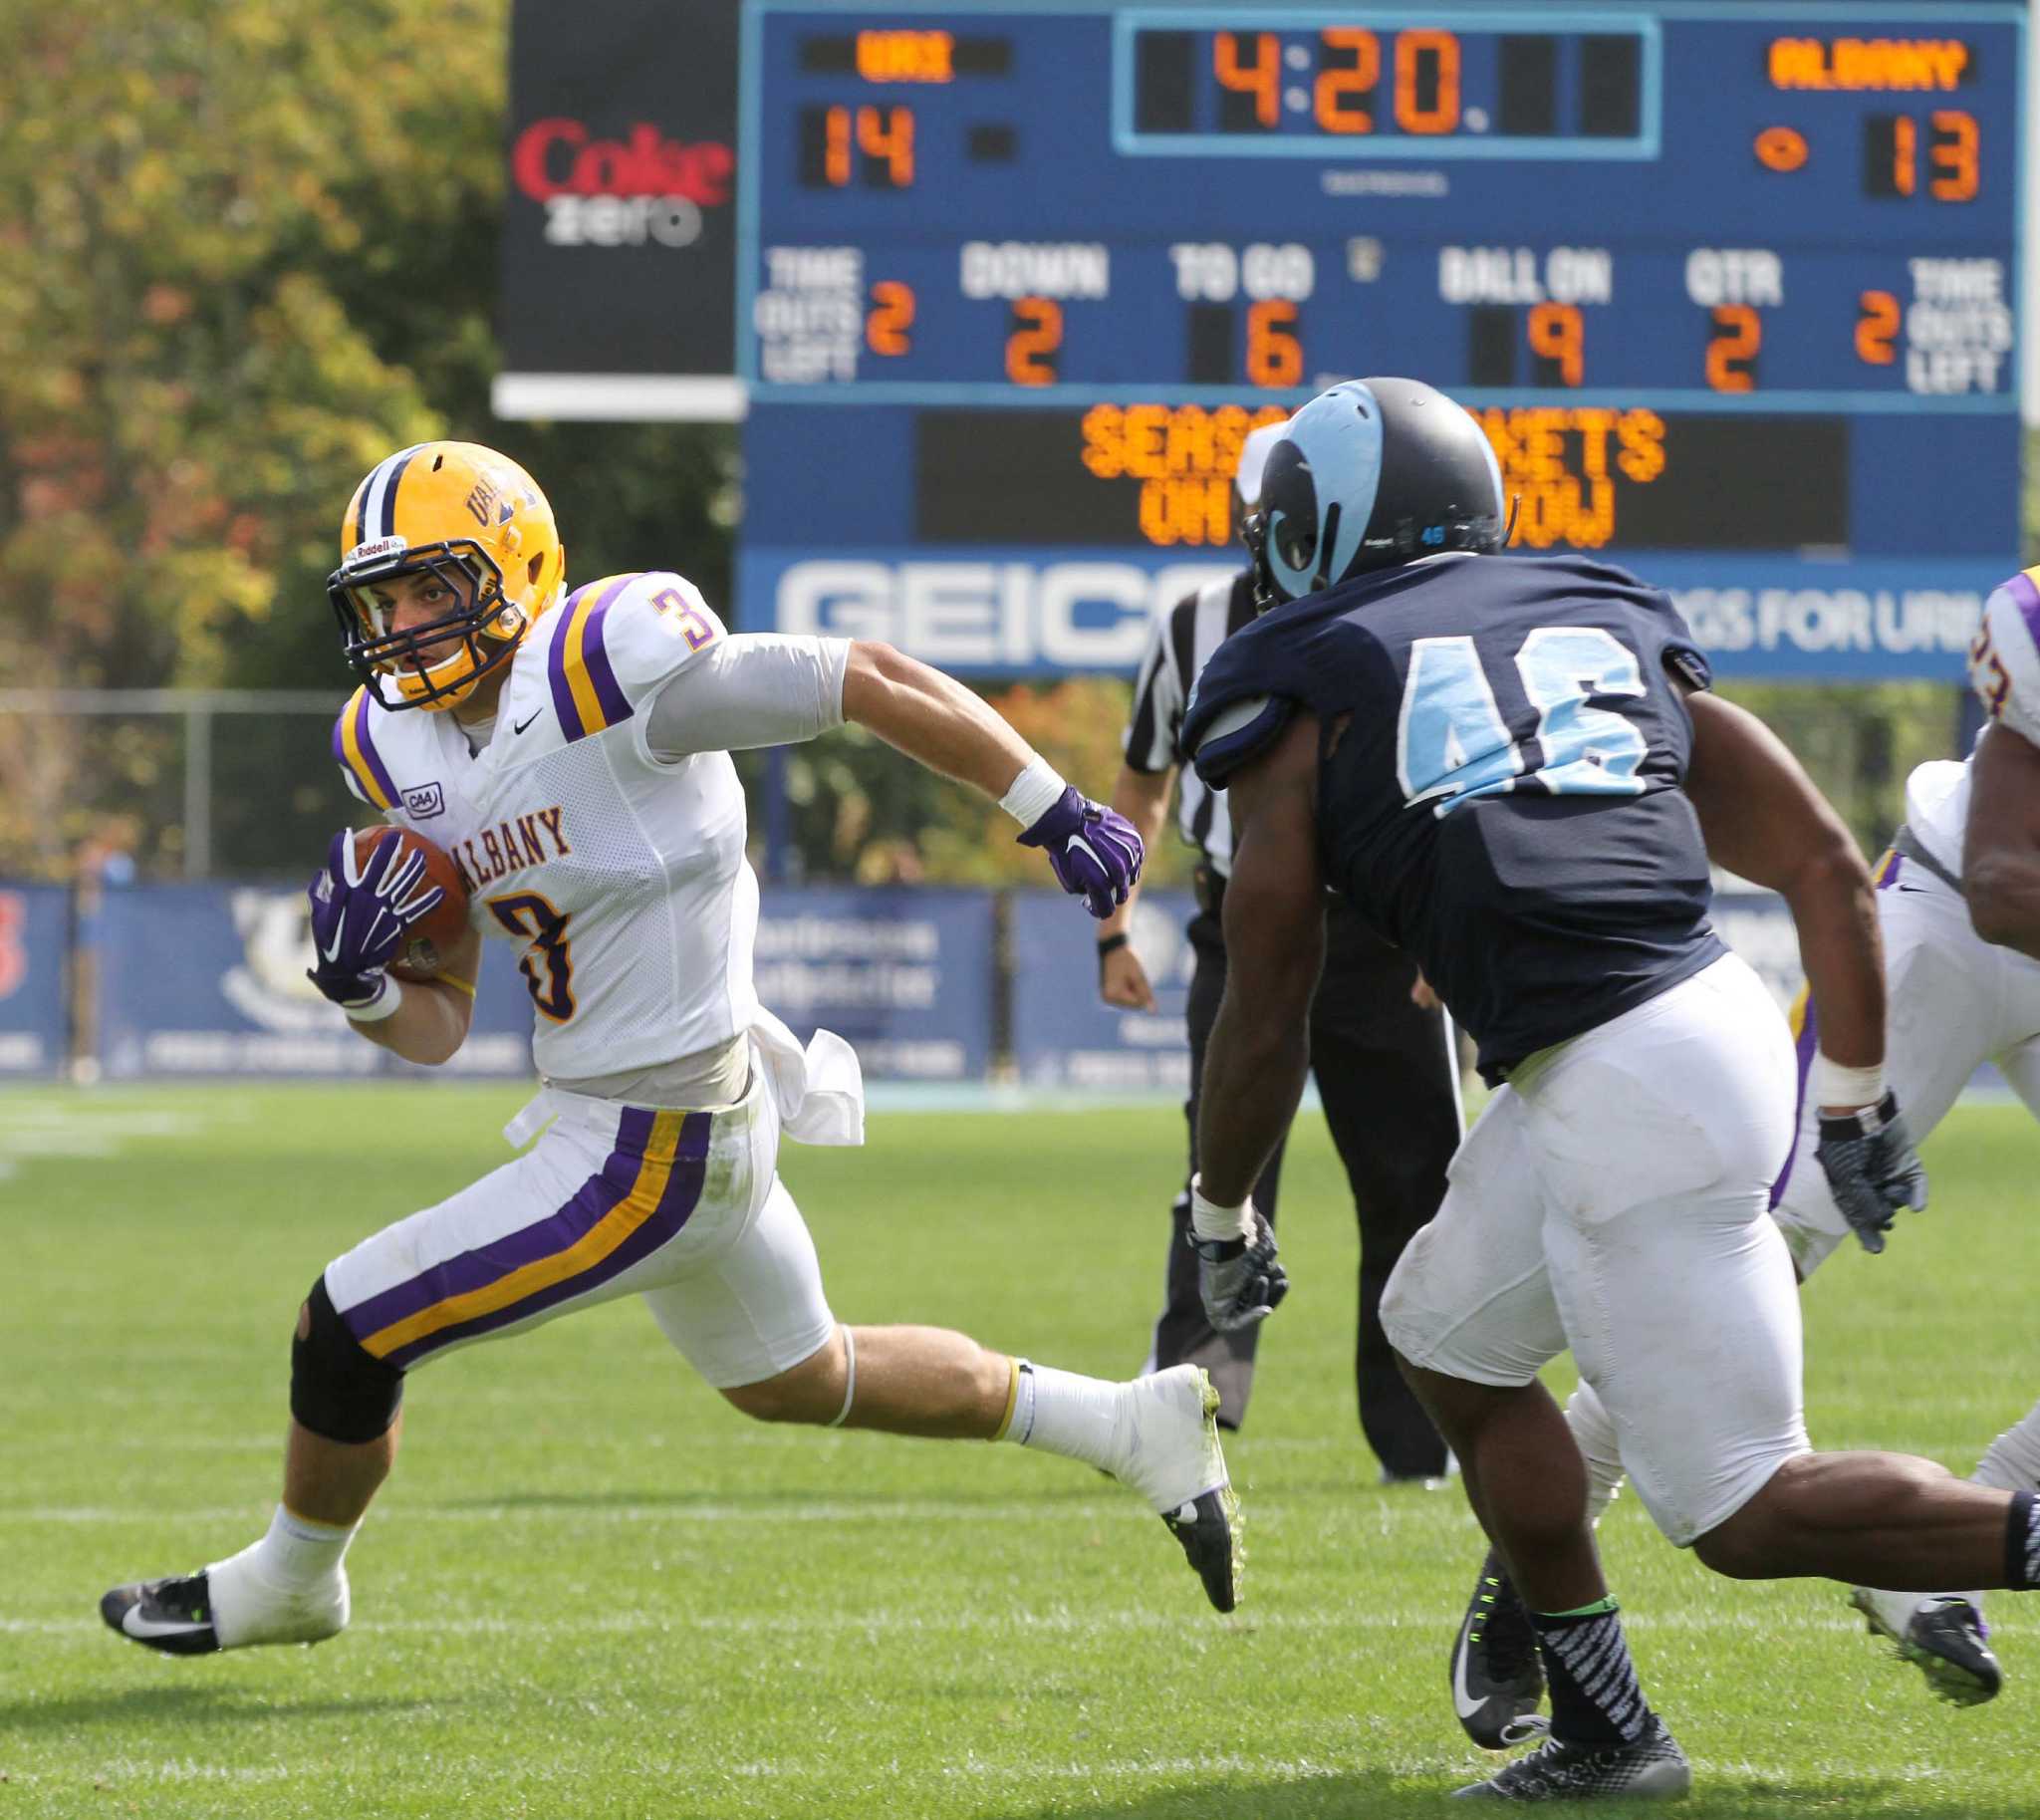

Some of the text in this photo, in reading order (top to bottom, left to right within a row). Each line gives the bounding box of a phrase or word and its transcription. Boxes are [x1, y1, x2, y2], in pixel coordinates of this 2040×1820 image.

[512, 118, 735, 205] Coke
[825, 105, 914, 187] 14
[1895, 110, 1979, 201] 13
[545, 194, 702, 247] zero
[766, 246, 863, 291] TIME
[960, 242, 1108, 299] DOWN
[1169, 242, 1315, 301] TO GO
[1438, 247, 1613, 303] BALL ON
[1685, 248, 1783, 307] QTR
[1909, 257, 2003, 302] TIME
[754, 291, 861, 339] OUTS
[866, 280, 915, 357] 2
[1005, 296, 1064, 388] 2
[1245, 298, 1304, 390] 6
[1527, 301, 1584, 388] 9
[1855, 290, 1901, 365] 2
[1906, 302, 2011, 352] OUTS
[763, 338, 858, 384] LEFT
[1704, 304, 1761, 394] 2
[1907, 349, 2002, 394] LEFT
[1082, 403, 1293, 479] SEAS
[357, 540, 389, 558] Riddell
[651, 587, 715, 653] 3
[1759, 589, 1873, 651] FOR
[1398, 626, 1651, 821] 46
[407, 791, 432, 808] CAA
[451, 804, 572, 896] ALBANY
[486, 889, 578, 1025] 3
